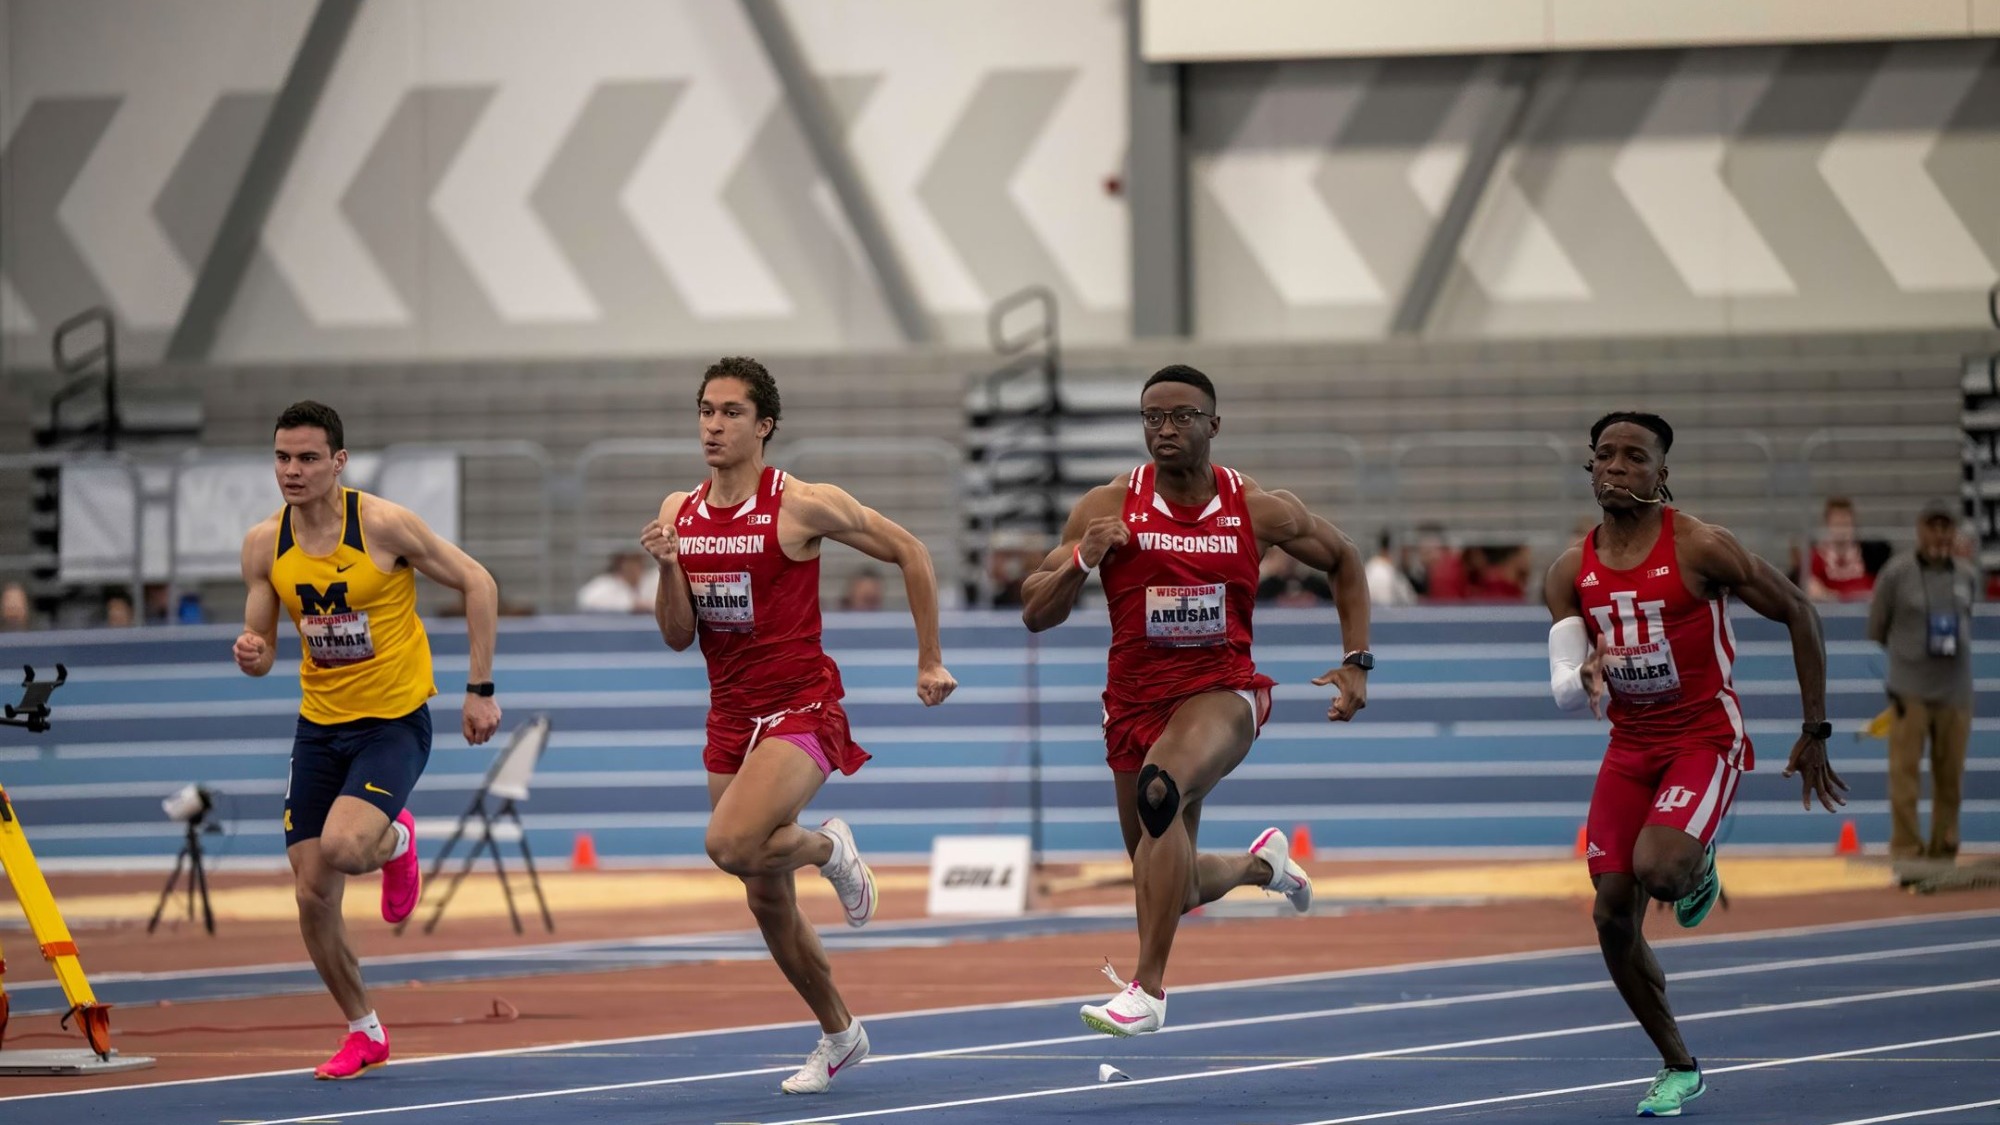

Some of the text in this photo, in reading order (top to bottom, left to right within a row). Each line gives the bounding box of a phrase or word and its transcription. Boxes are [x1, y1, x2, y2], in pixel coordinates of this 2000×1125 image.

[679, 535, 764, 555] WISCONSIN
[1137, 533, 1238, 553] WISCONSIN
[690, 574, 741, 583] WISCONSIN
[295, 582, 352, 615] M
[1157, 586, 1216, 597] WISCONSIN
[307, 613, 358, 625] WISCONSIN
[1151, 606, 1220, 623] AMUSAN
[306, 633, 366, 648] RUTMAN
[1606, 663, 1670, 680] LAIDLER
